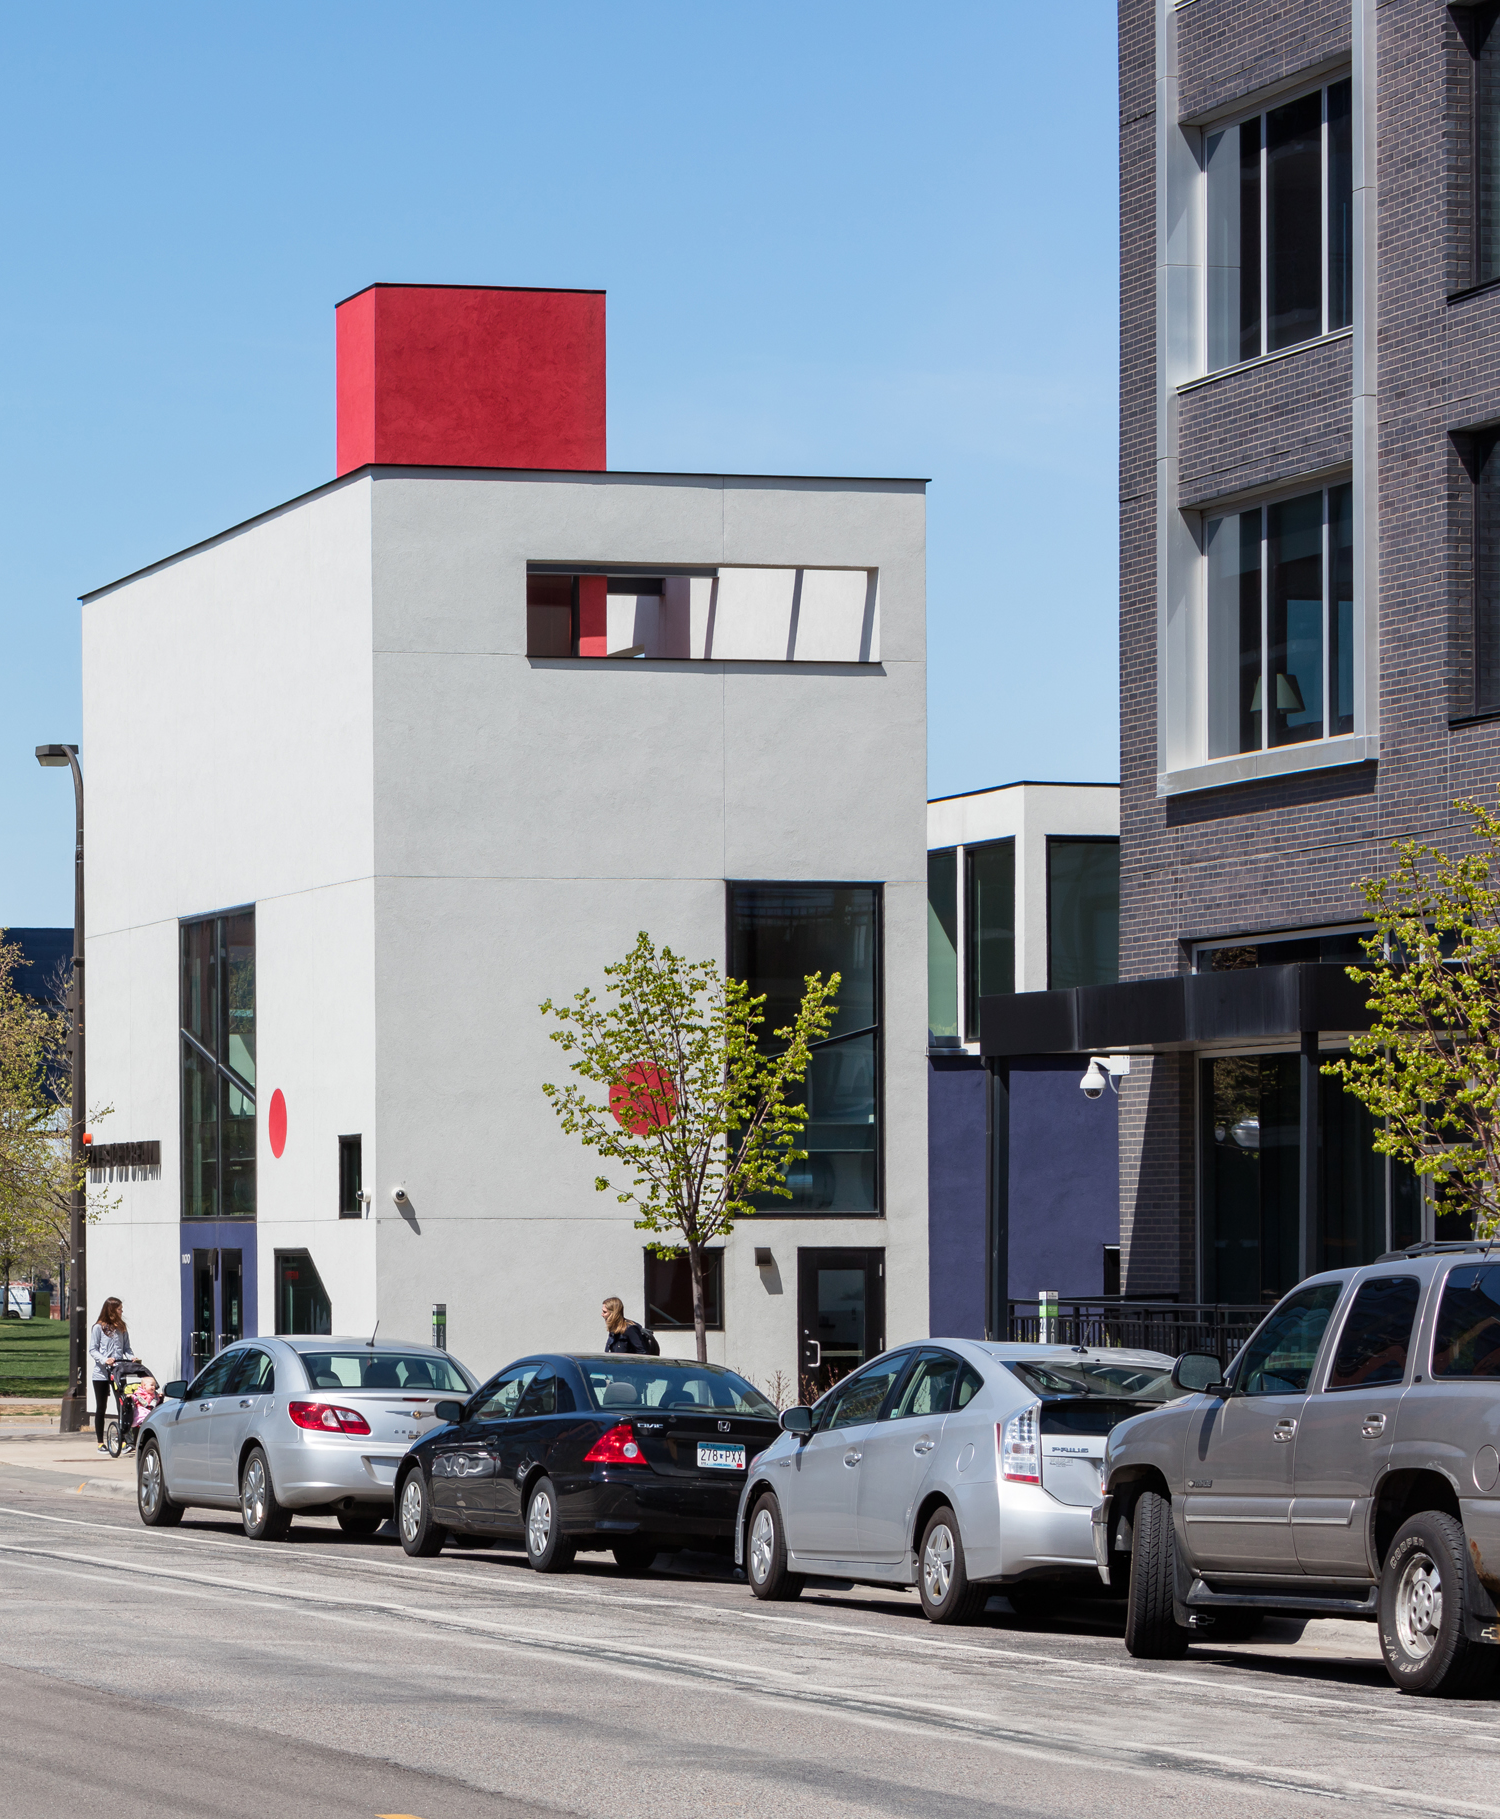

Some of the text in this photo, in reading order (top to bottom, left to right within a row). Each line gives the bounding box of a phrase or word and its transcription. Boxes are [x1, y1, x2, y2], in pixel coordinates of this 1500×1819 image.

[700, 1448, 743, 1463] 278 PXX
[1051, 1446, 1089, 1454] PRIUS
[1389, 1536, 1425, 1570] COOPER
